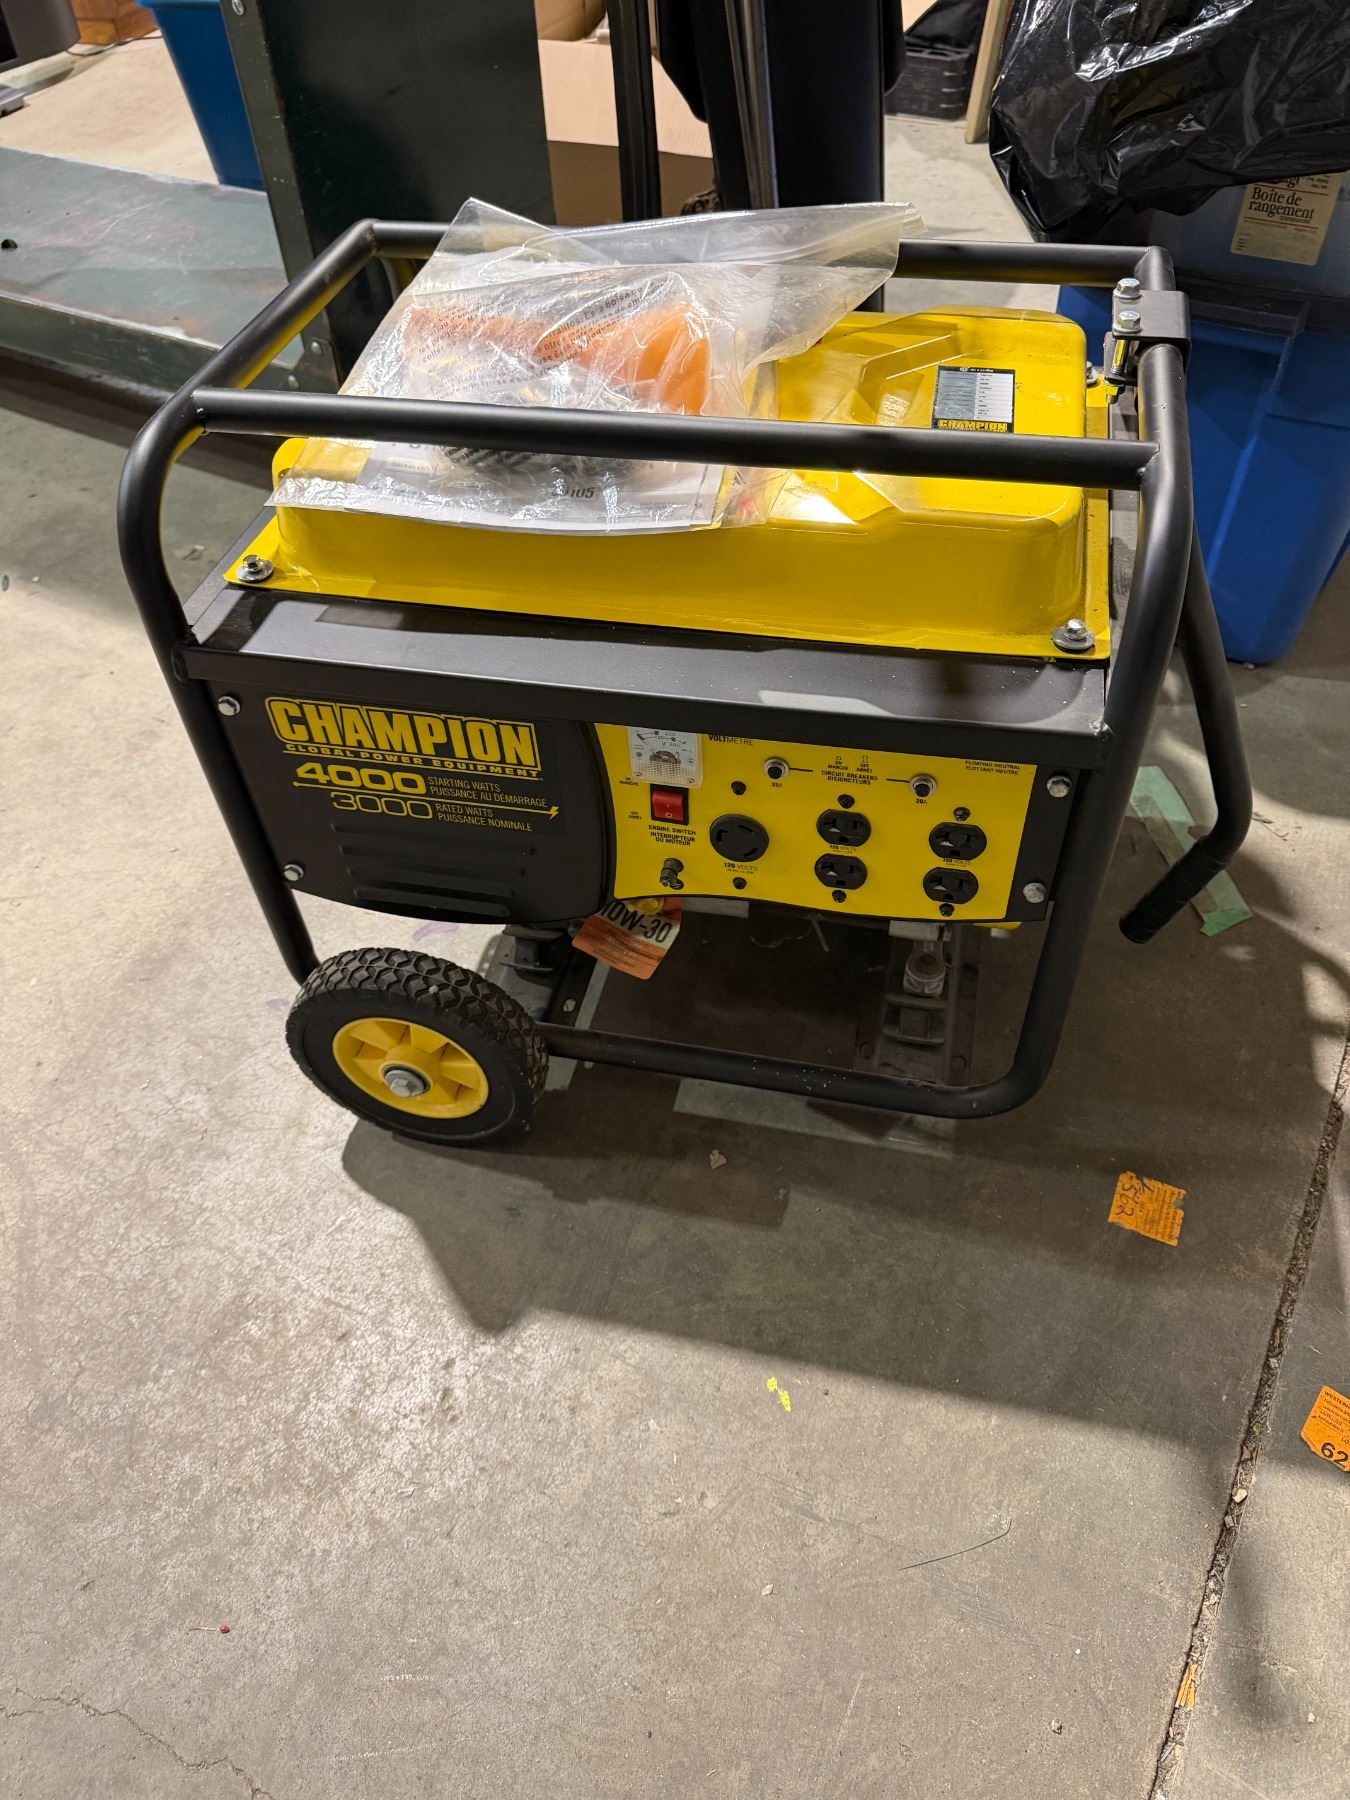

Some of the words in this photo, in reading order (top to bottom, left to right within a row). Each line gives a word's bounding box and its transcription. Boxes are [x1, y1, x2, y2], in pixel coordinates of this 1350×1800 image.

[1286, 192, 1303, 206] de
[1248, 200, 1315, 219] rangement
[268, 699, 538, 767] CHAMPION
[285, 743, 354, 759] GLOBAL
[360, 752, 423, 766] POWER
[432, 759, 540, 778] EQUIPMENT
[296, 762, 427, 795] 4000
[428, 776, 470, 791] STARTING
[472, 781, 501, 793] WATTS
[821, 770, 846, 779] CIRCUIT
[847, 773, 878, 782] BREAKERS
[430, 786, 479, 801] PUISSANCE
[480, 792, 493, 802] AU
[331, 792, 433, 819] 3000
[436, 803, 464, 815] RATED
[465, 806, 493, 818] WATTS
[438, 812, 486, 826] PUISSANCE
[488, 818, 533, 832] NOMINALE
[649, 824, 671, 834] ENGINE
[672, 827, 697, 836] SWITCH
[666, 838, 691, 847] MOTEUR
[724, 862, 736, 870] 120
[1320, 1442, 1349, 1463] 62
